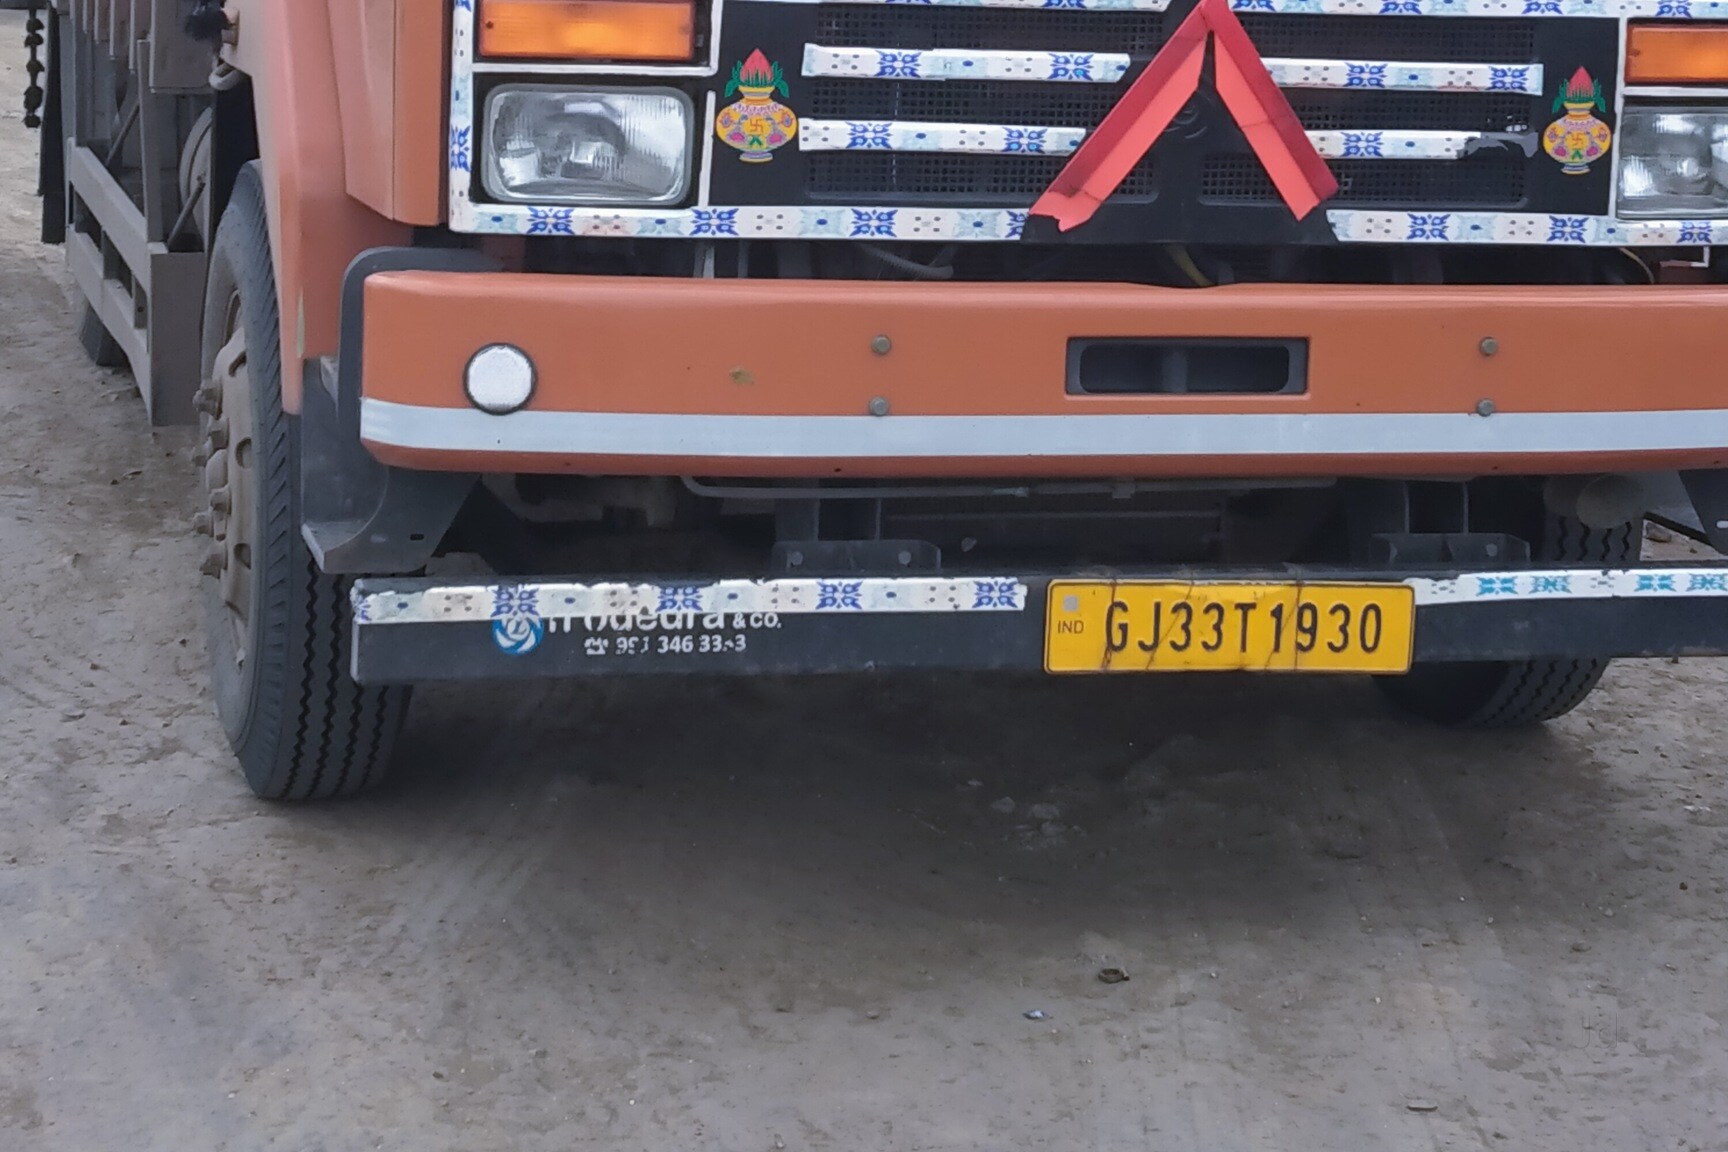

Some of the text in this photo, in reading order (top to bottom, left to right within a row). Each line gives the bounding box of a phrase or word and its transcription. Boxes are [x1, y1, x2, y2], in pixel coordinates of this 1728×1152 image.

[1057, 620, 1084, 635] IND
[1105, 600, 1382, 654] GJ33T1930
[657, 635, 694, 653] 346
